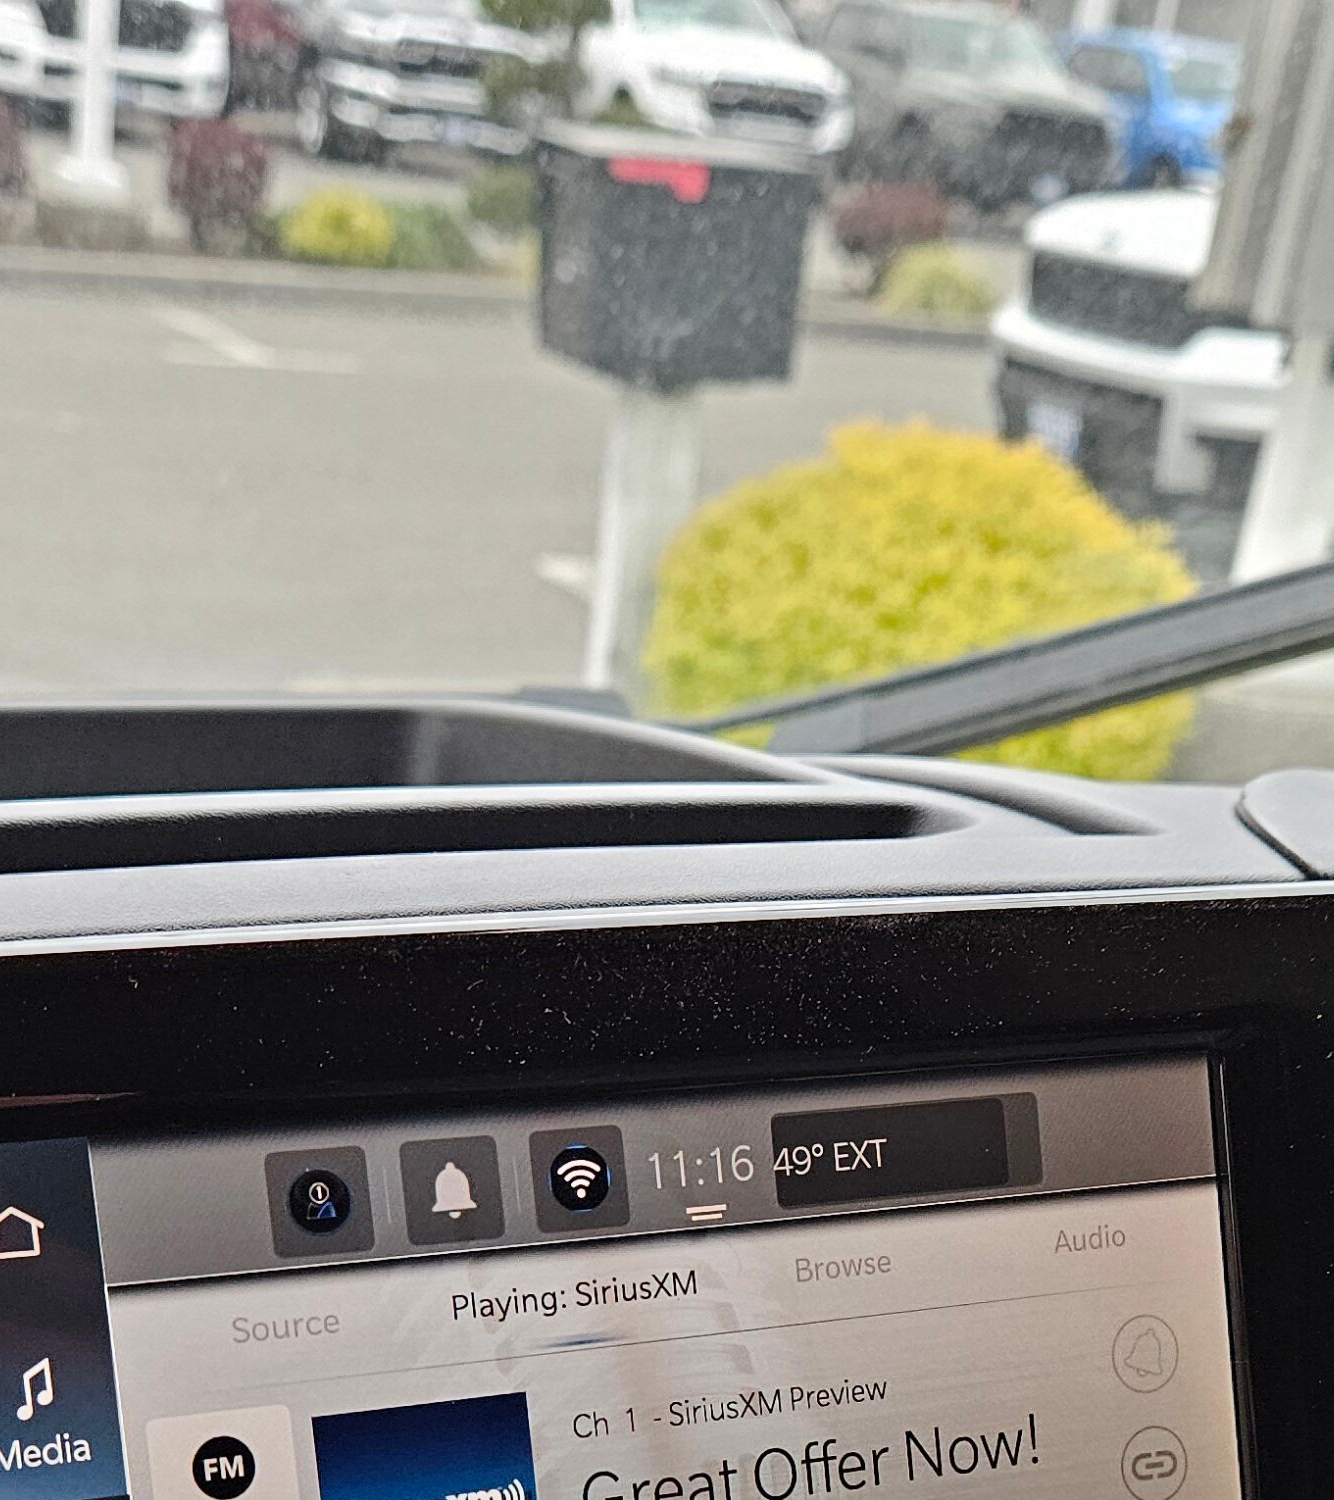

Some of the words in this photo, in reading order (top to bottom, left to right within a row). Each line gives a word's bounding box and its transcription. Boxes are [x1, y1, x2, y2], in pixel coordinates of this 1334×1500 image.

[648, 1146, 754, 1190] 11:16
[773, 1143, 825, 1177] 49°
[834, 1139, 888, 1172] EXT
[1054, 1224, 1126, 1255] Audio
[795, 1252, 892, 1283] Browse
[452, 1285, 567, 1322] Playing:
[575, 1270, 698, 1307] SiriusXM
[232, 1313, 340, 1344] Source
[572, 1411, 609, 1439] Ch
[626, 1408, 636, 1433] 1
[669, 1390, 782, 1427] SiriusXM
[790, 1377, 888, 1411] Preview
[904, 1413, 1040, 1481] Now!
[203, 1455, 245, 1481] FM
